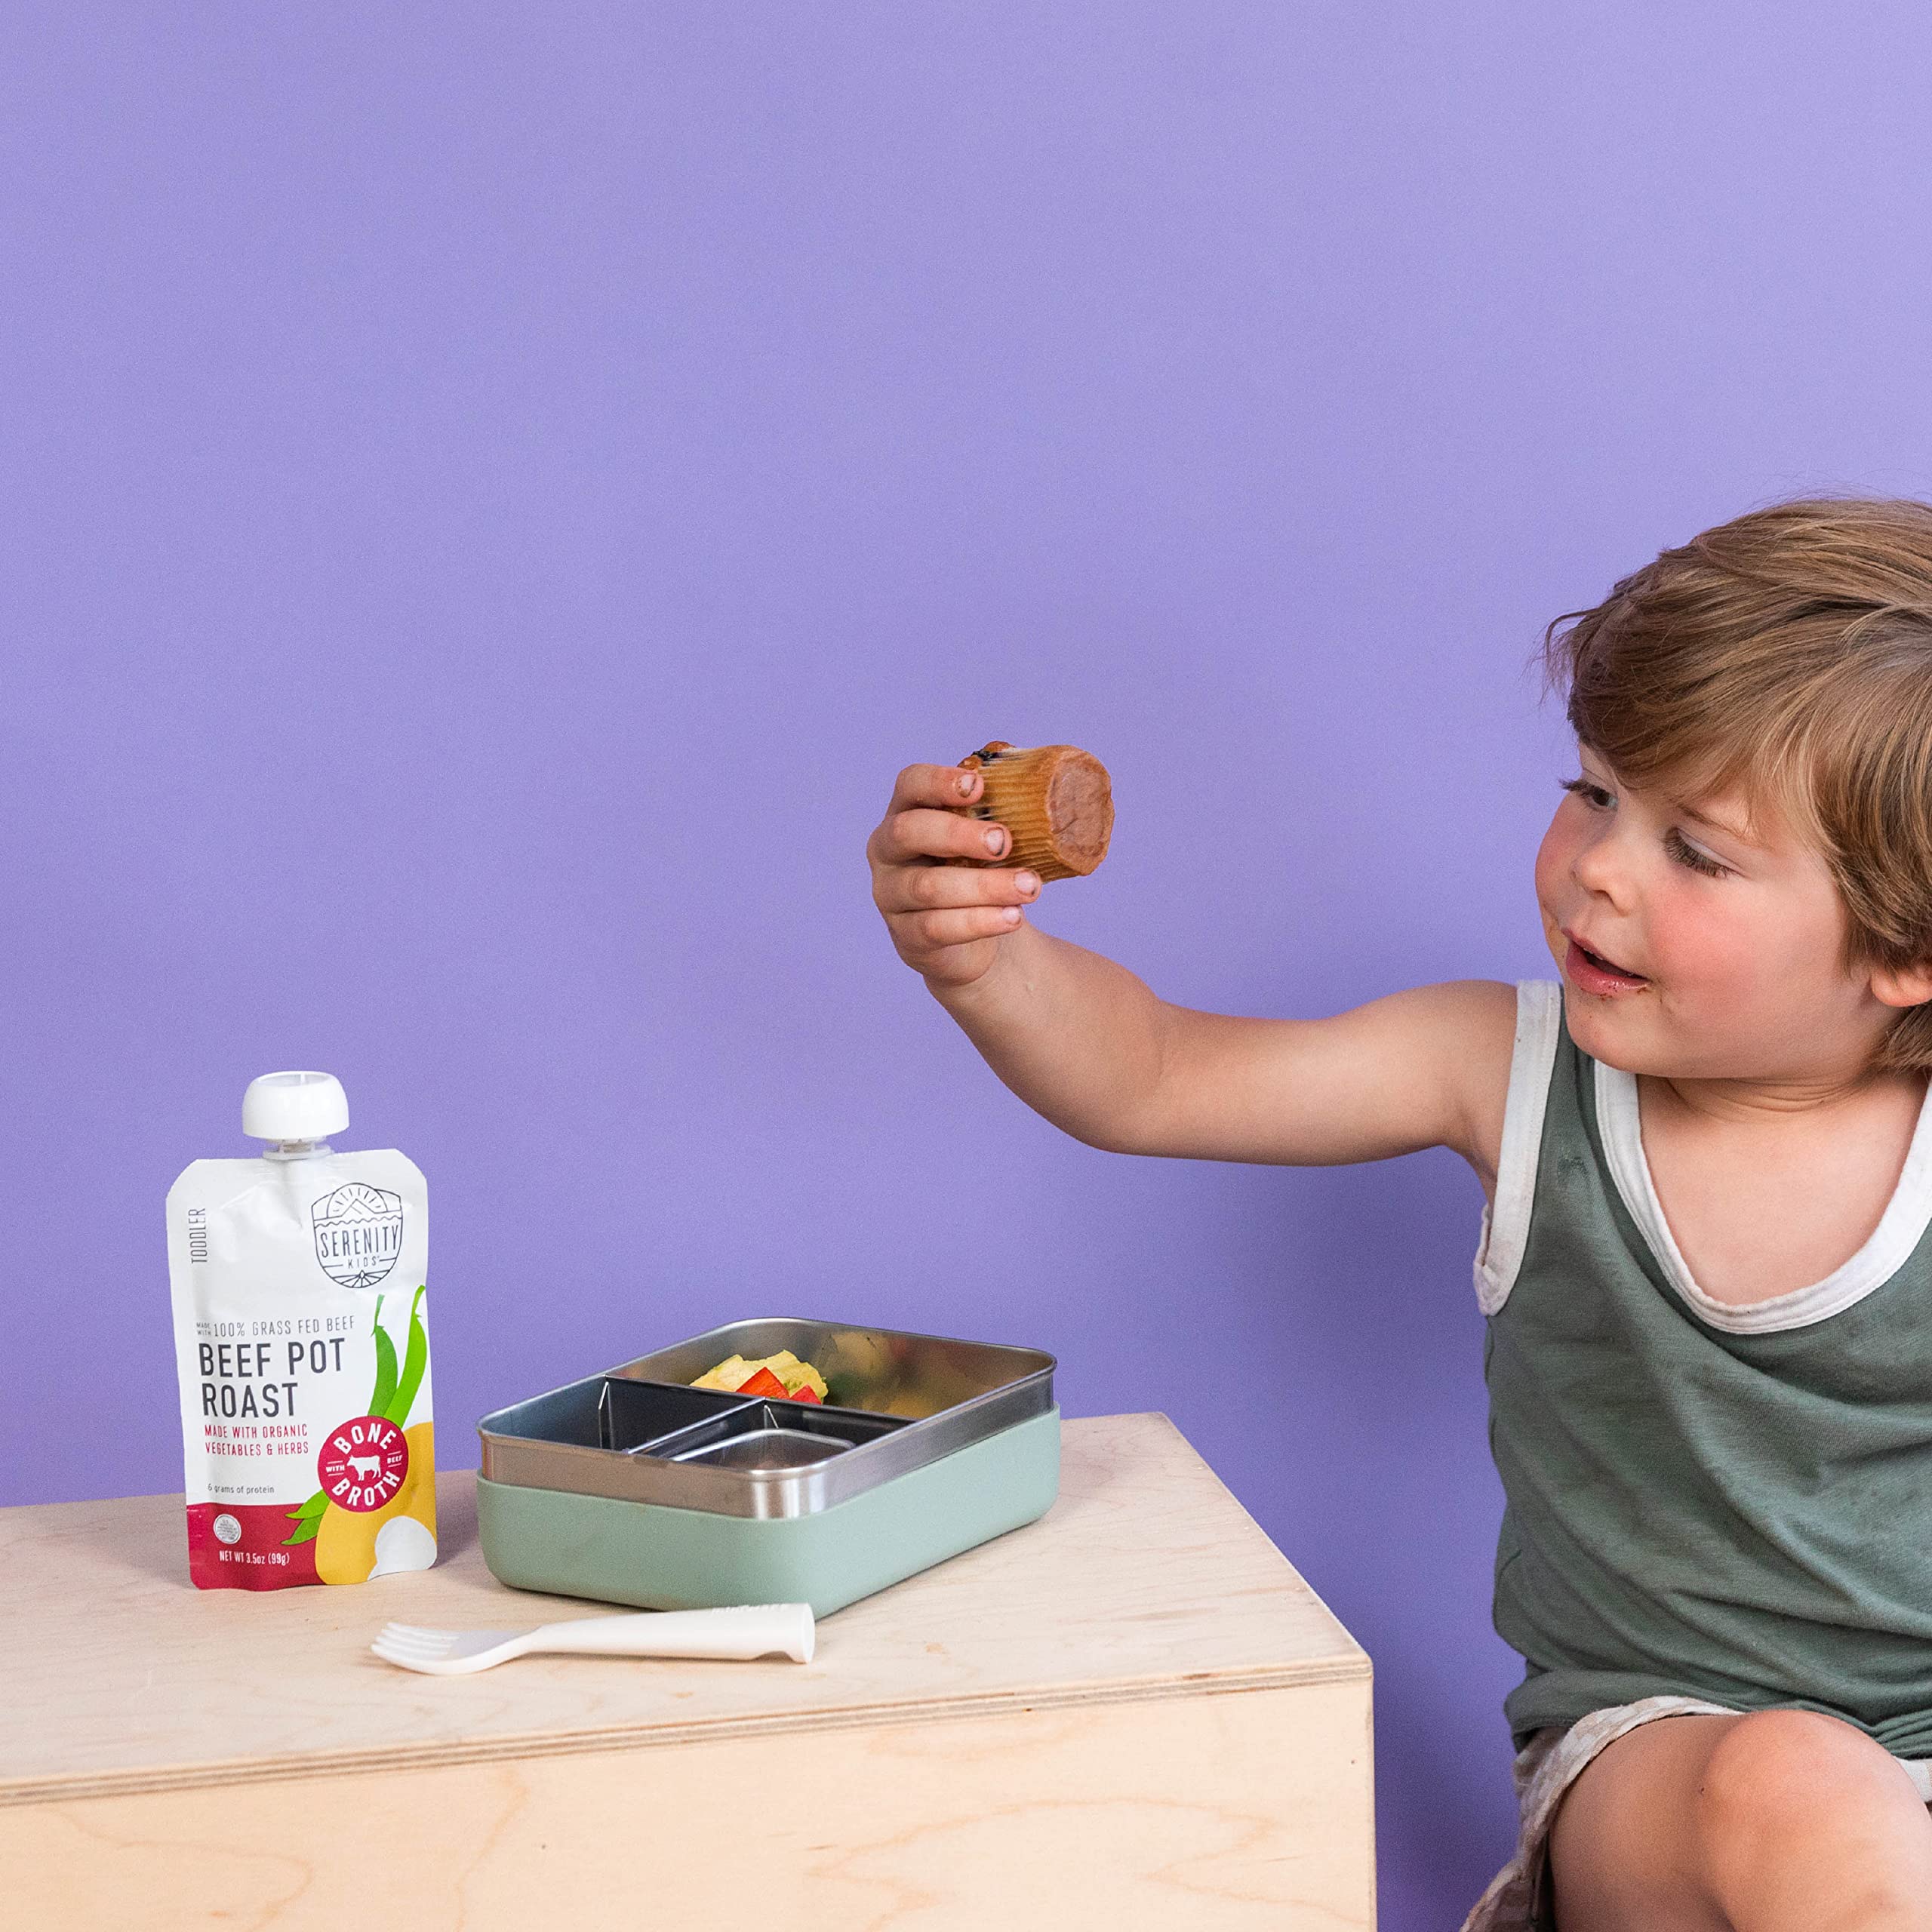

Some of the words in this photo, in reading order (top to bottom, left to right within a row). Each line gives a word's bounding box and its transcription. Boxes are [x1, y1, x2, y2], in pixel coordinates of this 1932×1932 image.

[188, 1208, 208, 1264] TODDLER
[320, 1224, 398, 1258] SERENITY
[348, 1255, 377, 1269] KIDS
[214, 1321, 245, 1337] 100%
[252, 1320, 291, 1336] GRASS
[297, 1318, 320, 1334] FED
[327, 1315, 355, 1331] BEEF
[198, 1343, 271, 1377] BEEF
[288, 1337, 345, 1376] POT
[202, 1382, 298, 1418] ROAST
[205, 1424, 227, 1438] MADE
[232, 1425, 257, 1439] WITH
[263, 1424, 308, 1438] ORGANIC
[333, 1423, 397, 1454] BONE
[205, 1441, 261, 1456] VEGETABLES
[266, 1442, 272, 1455] &
[278, 1441, 309, 1455] HERBS
[386, 1455, 402, 1464] BEEF
[214, 1484, 235, 1494] grams
[235, 1485, 244, 1494] of
[246, 1486, 275, 1495] protein
[332, 1471, 400, 1506] BROTH
[219, 1550, 232, 1562] NET
[234, 1552, 244, 1563] WT
[245, 1552, 265, 1564] 3.5oz
[268, 1552, 290, 1567] (99g)
